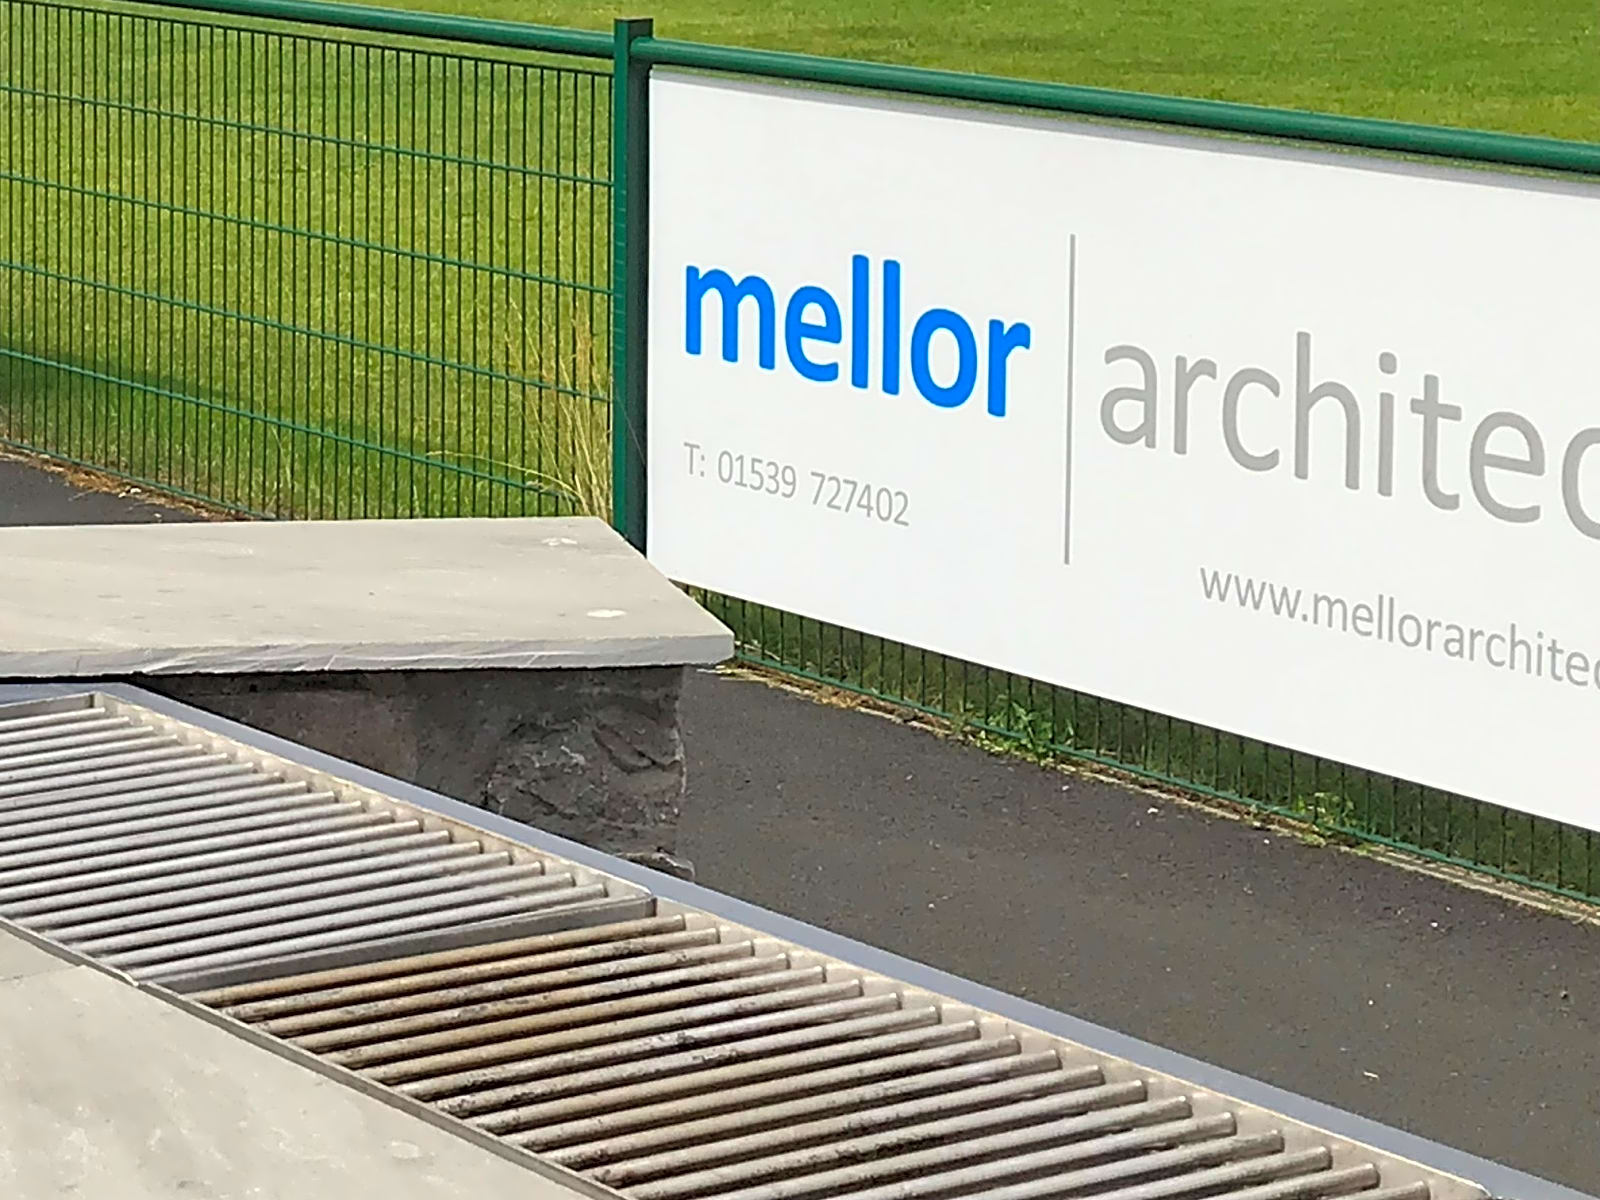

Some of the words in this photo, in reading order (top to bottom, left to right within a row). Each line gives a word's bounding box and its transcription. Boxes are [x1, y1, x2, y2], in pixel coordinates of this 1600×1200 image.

[685, 254, 1032, 418] mellor
[683, 441, 705, 478] T:
[718, 450, 797, 499] 01539
[811, 471, 910, 527] 727402
[1200, 567, 1600, 691] www.mellorarchite
